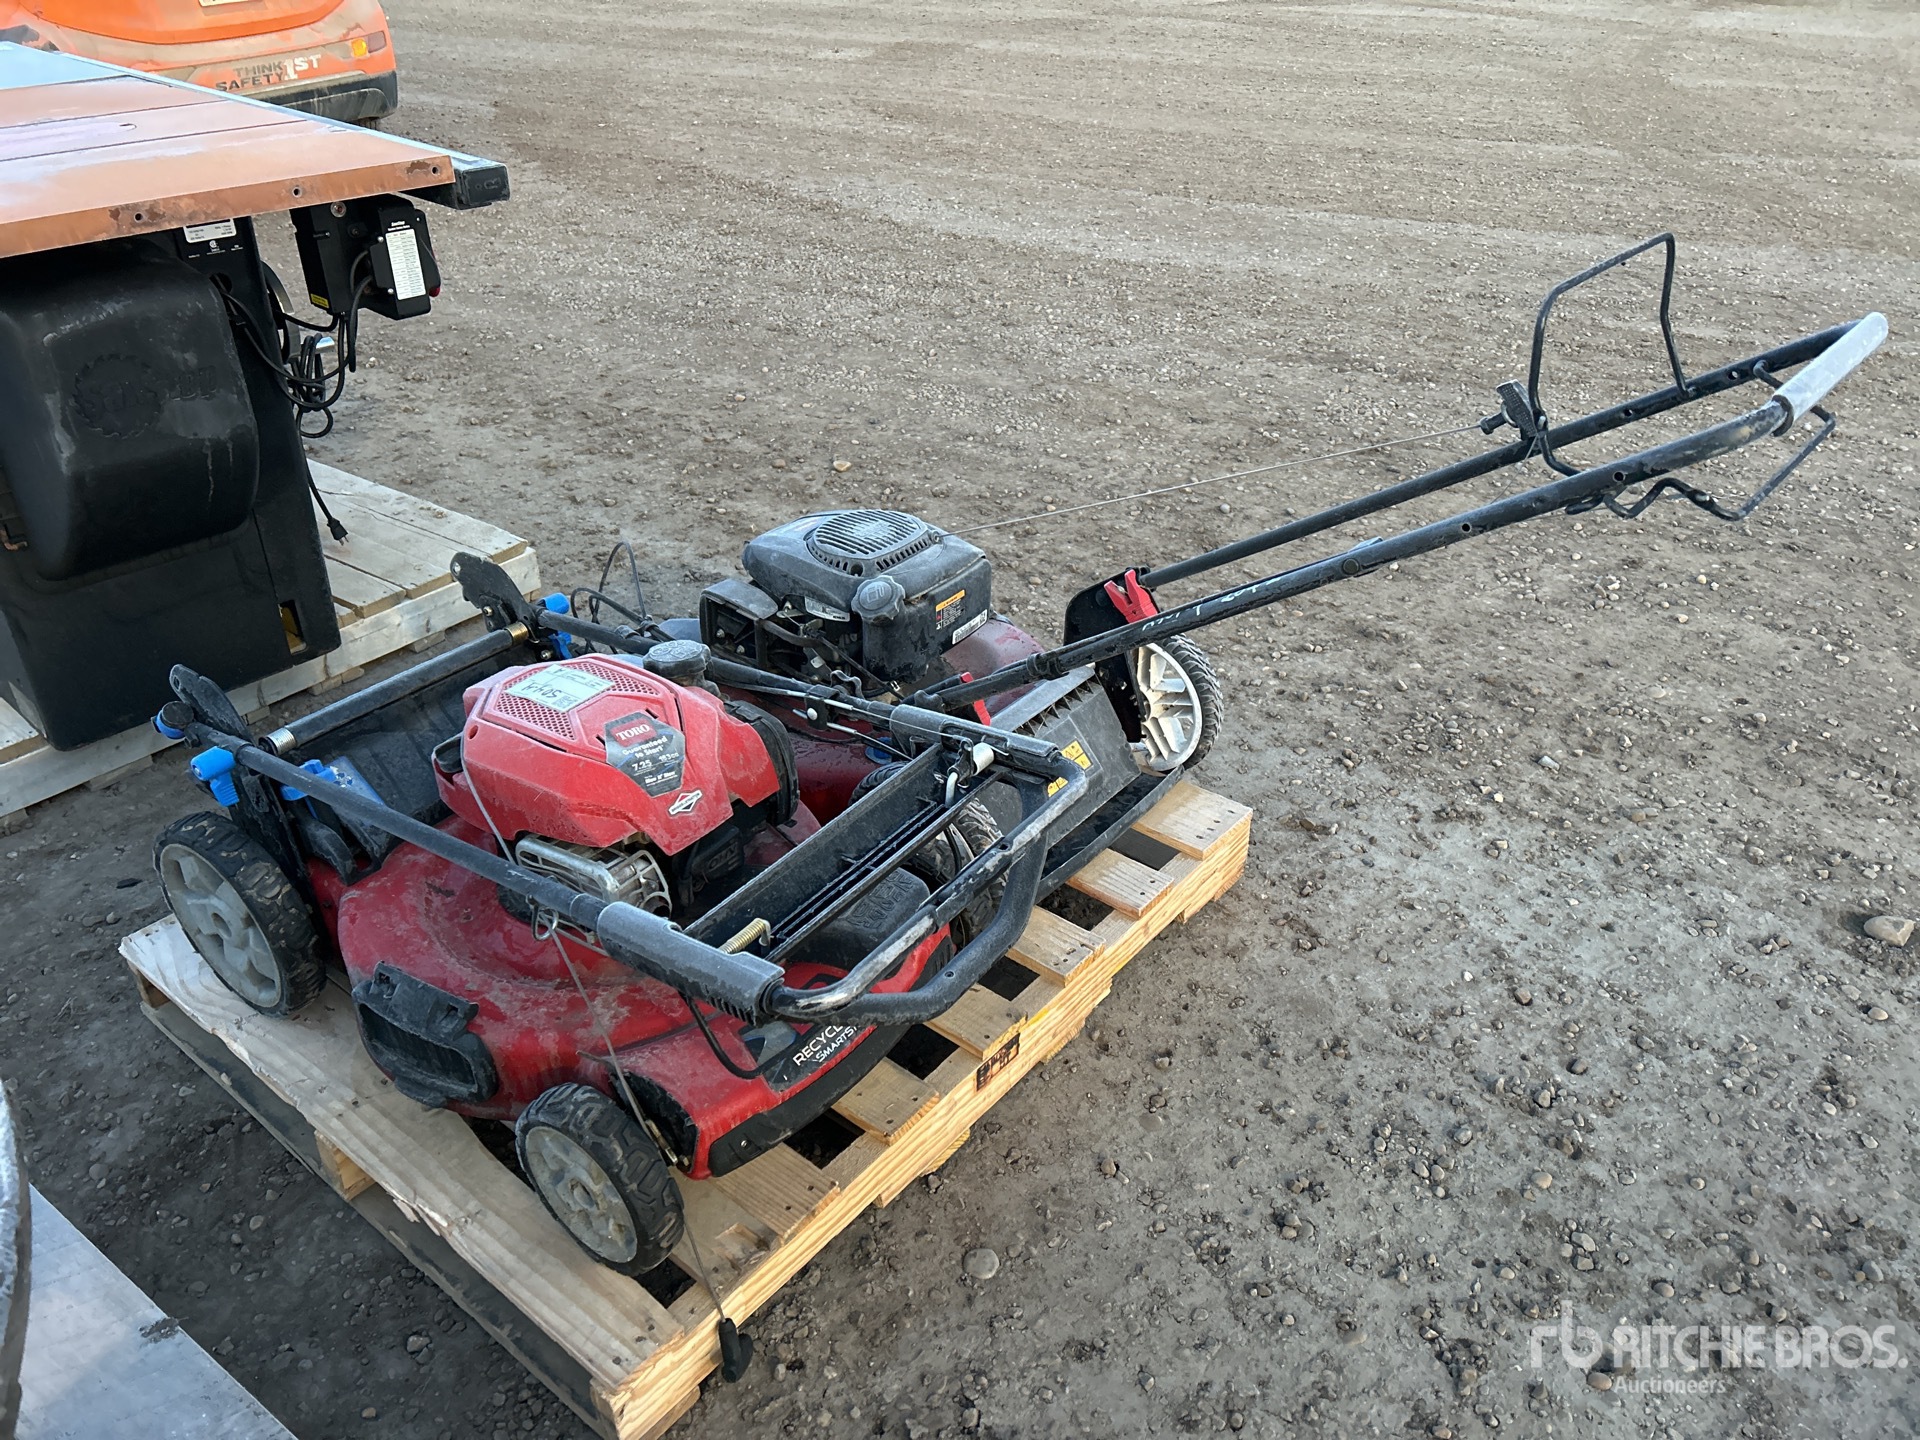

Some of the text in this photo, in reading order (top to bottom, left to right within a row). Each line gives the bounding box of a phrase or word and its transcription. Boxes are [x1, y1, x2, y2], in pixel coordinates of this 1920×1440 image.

[234, 61, 284, 78] THINK
[284, 54, 322, 80] 1ST
[215, 72, 284, 92] SAFETY
[615, 724, 651, 741] TORO
[622, 736, 669, 756] Guaranteed
[632, 759, 653, 771] 7.25
